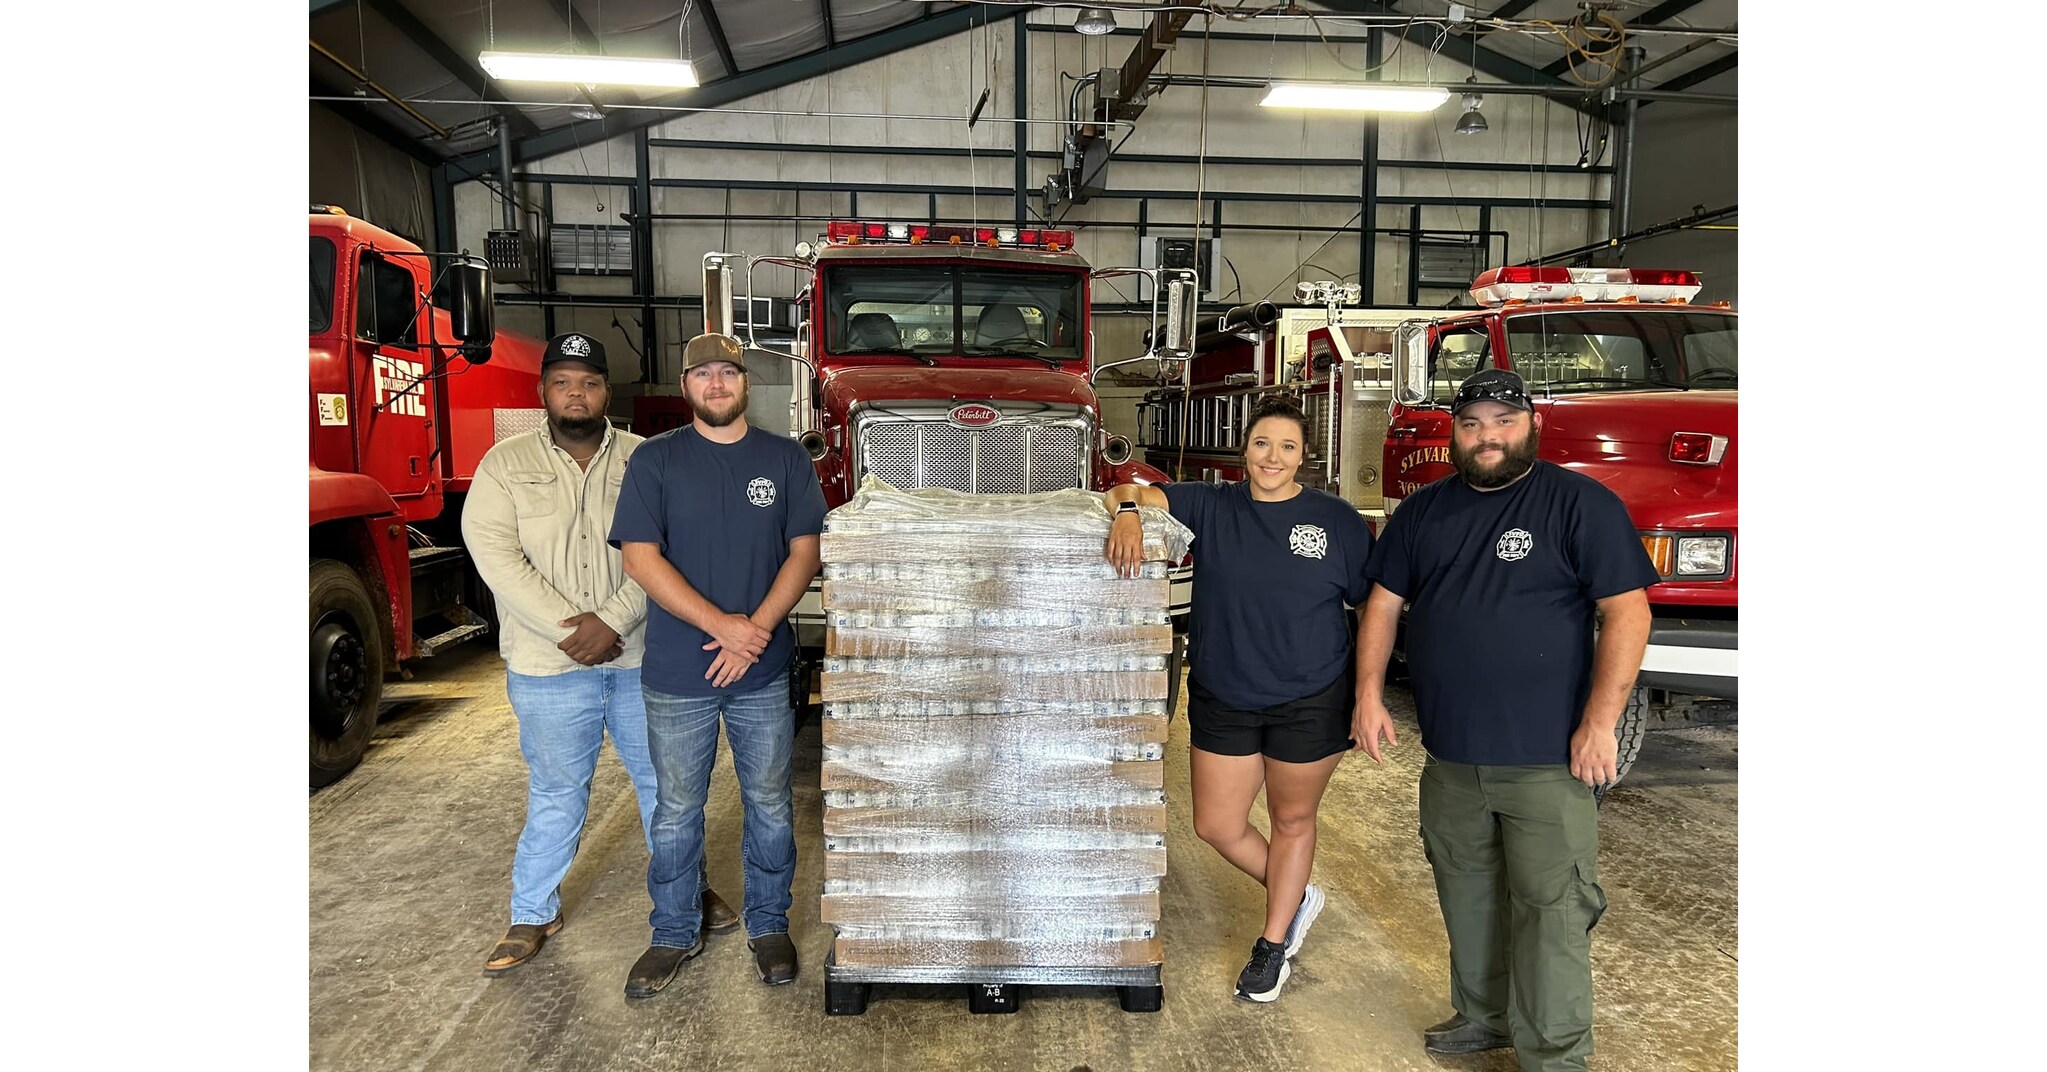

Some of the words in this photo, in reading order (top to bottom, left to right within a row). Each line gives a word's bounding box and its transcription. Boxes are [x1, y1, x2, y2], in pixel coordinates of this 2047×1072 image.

[372, 354, 426, 417] FIRE
[957, 408, 993, 420] Peterbilt
[1400, 446, 1454, 474] SYLVAR
